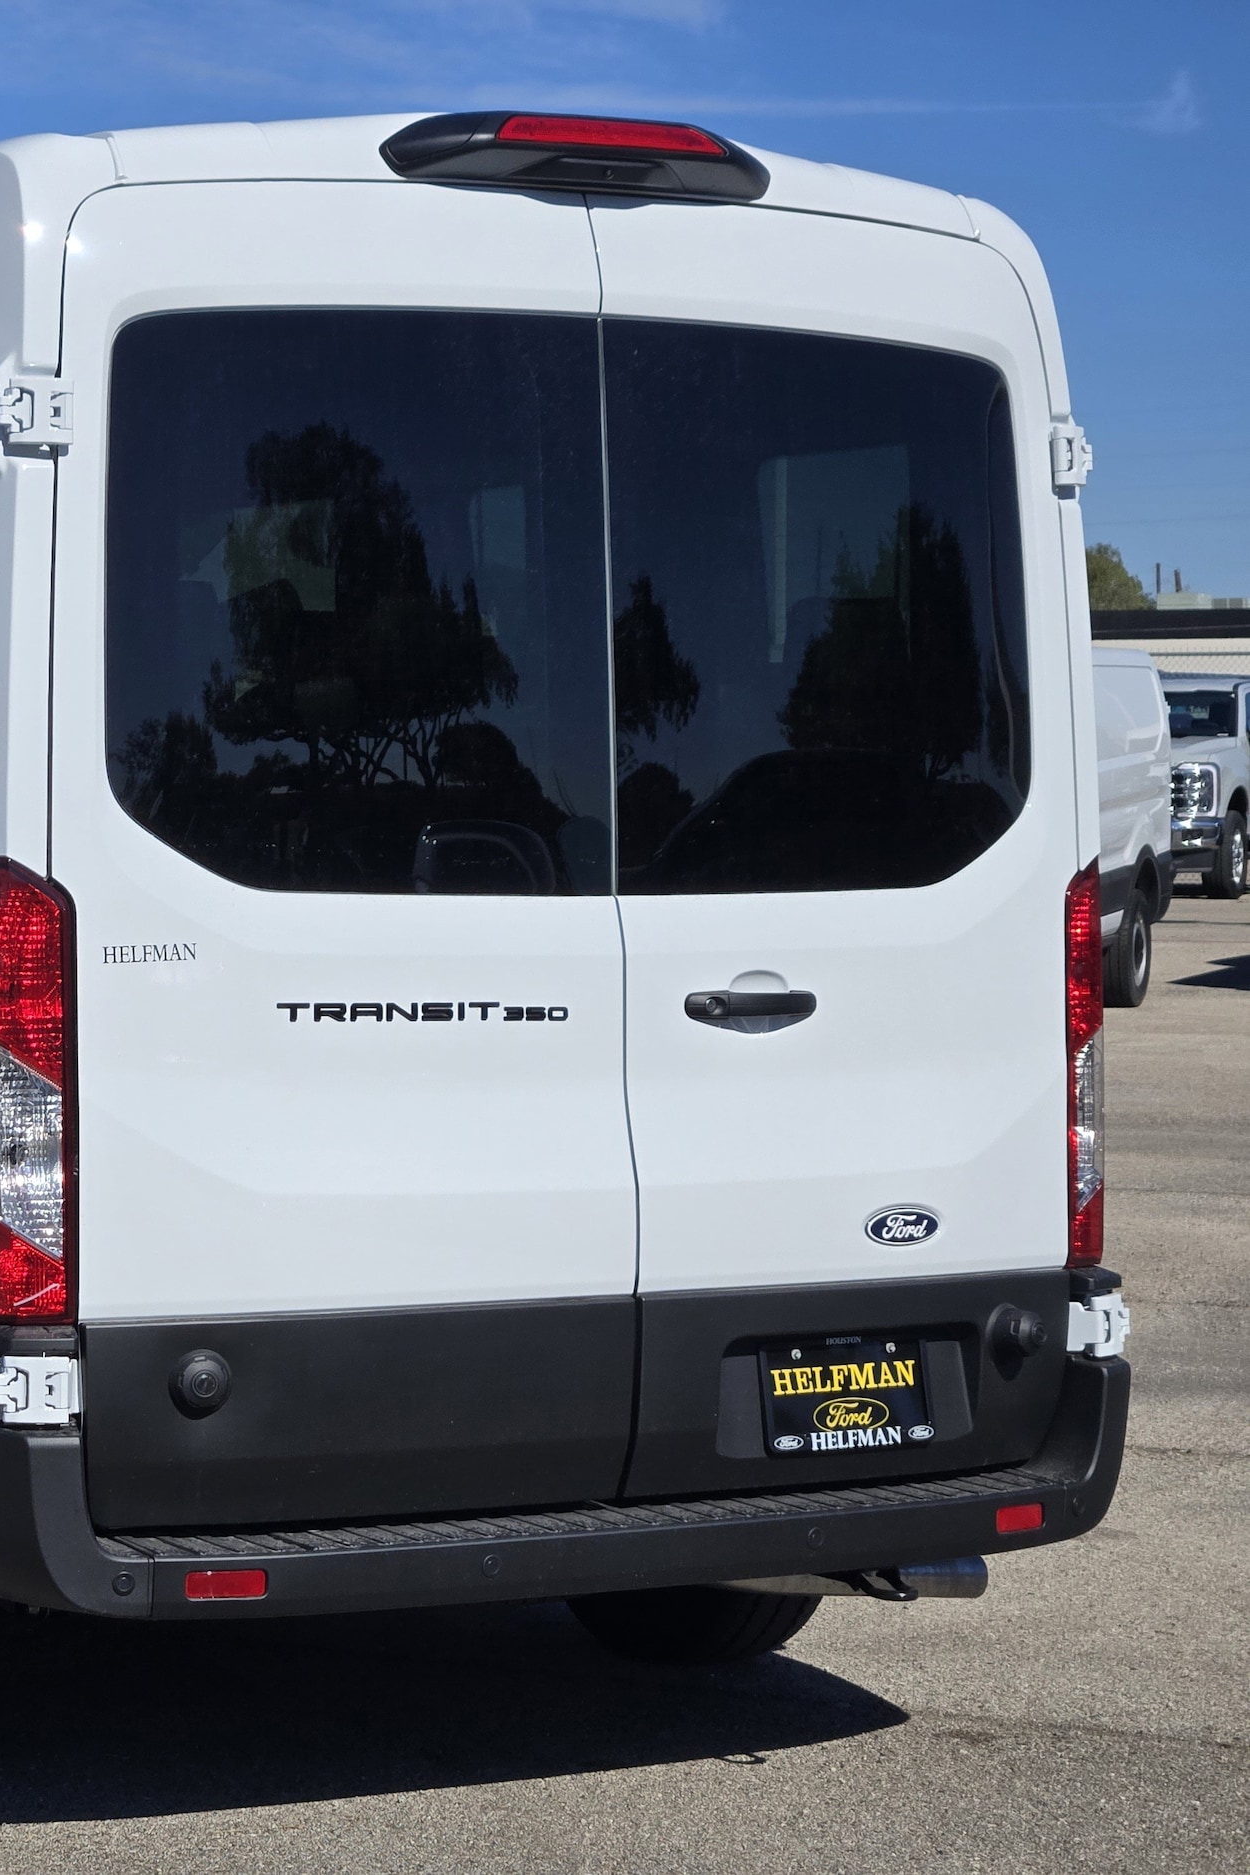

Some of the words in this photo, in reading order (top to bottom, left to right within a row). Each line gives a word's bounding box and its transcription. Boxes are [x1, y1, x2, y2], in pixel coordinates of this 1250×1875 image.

[102, 942, 198, 965] HELFMAN
[276, 1001, 501, 1023] TRANSIT
[503, 1005, 570, 1023] 350
[881, 1214, 929, 1240] Ford
[825, 1335, 862, 1346] HOUSTON
[770, 1359, 916, 1396] HELFMAN
[825, 1402, 873, 1428] Ford
[810, 1426, 902, 1452] HELFMAN
